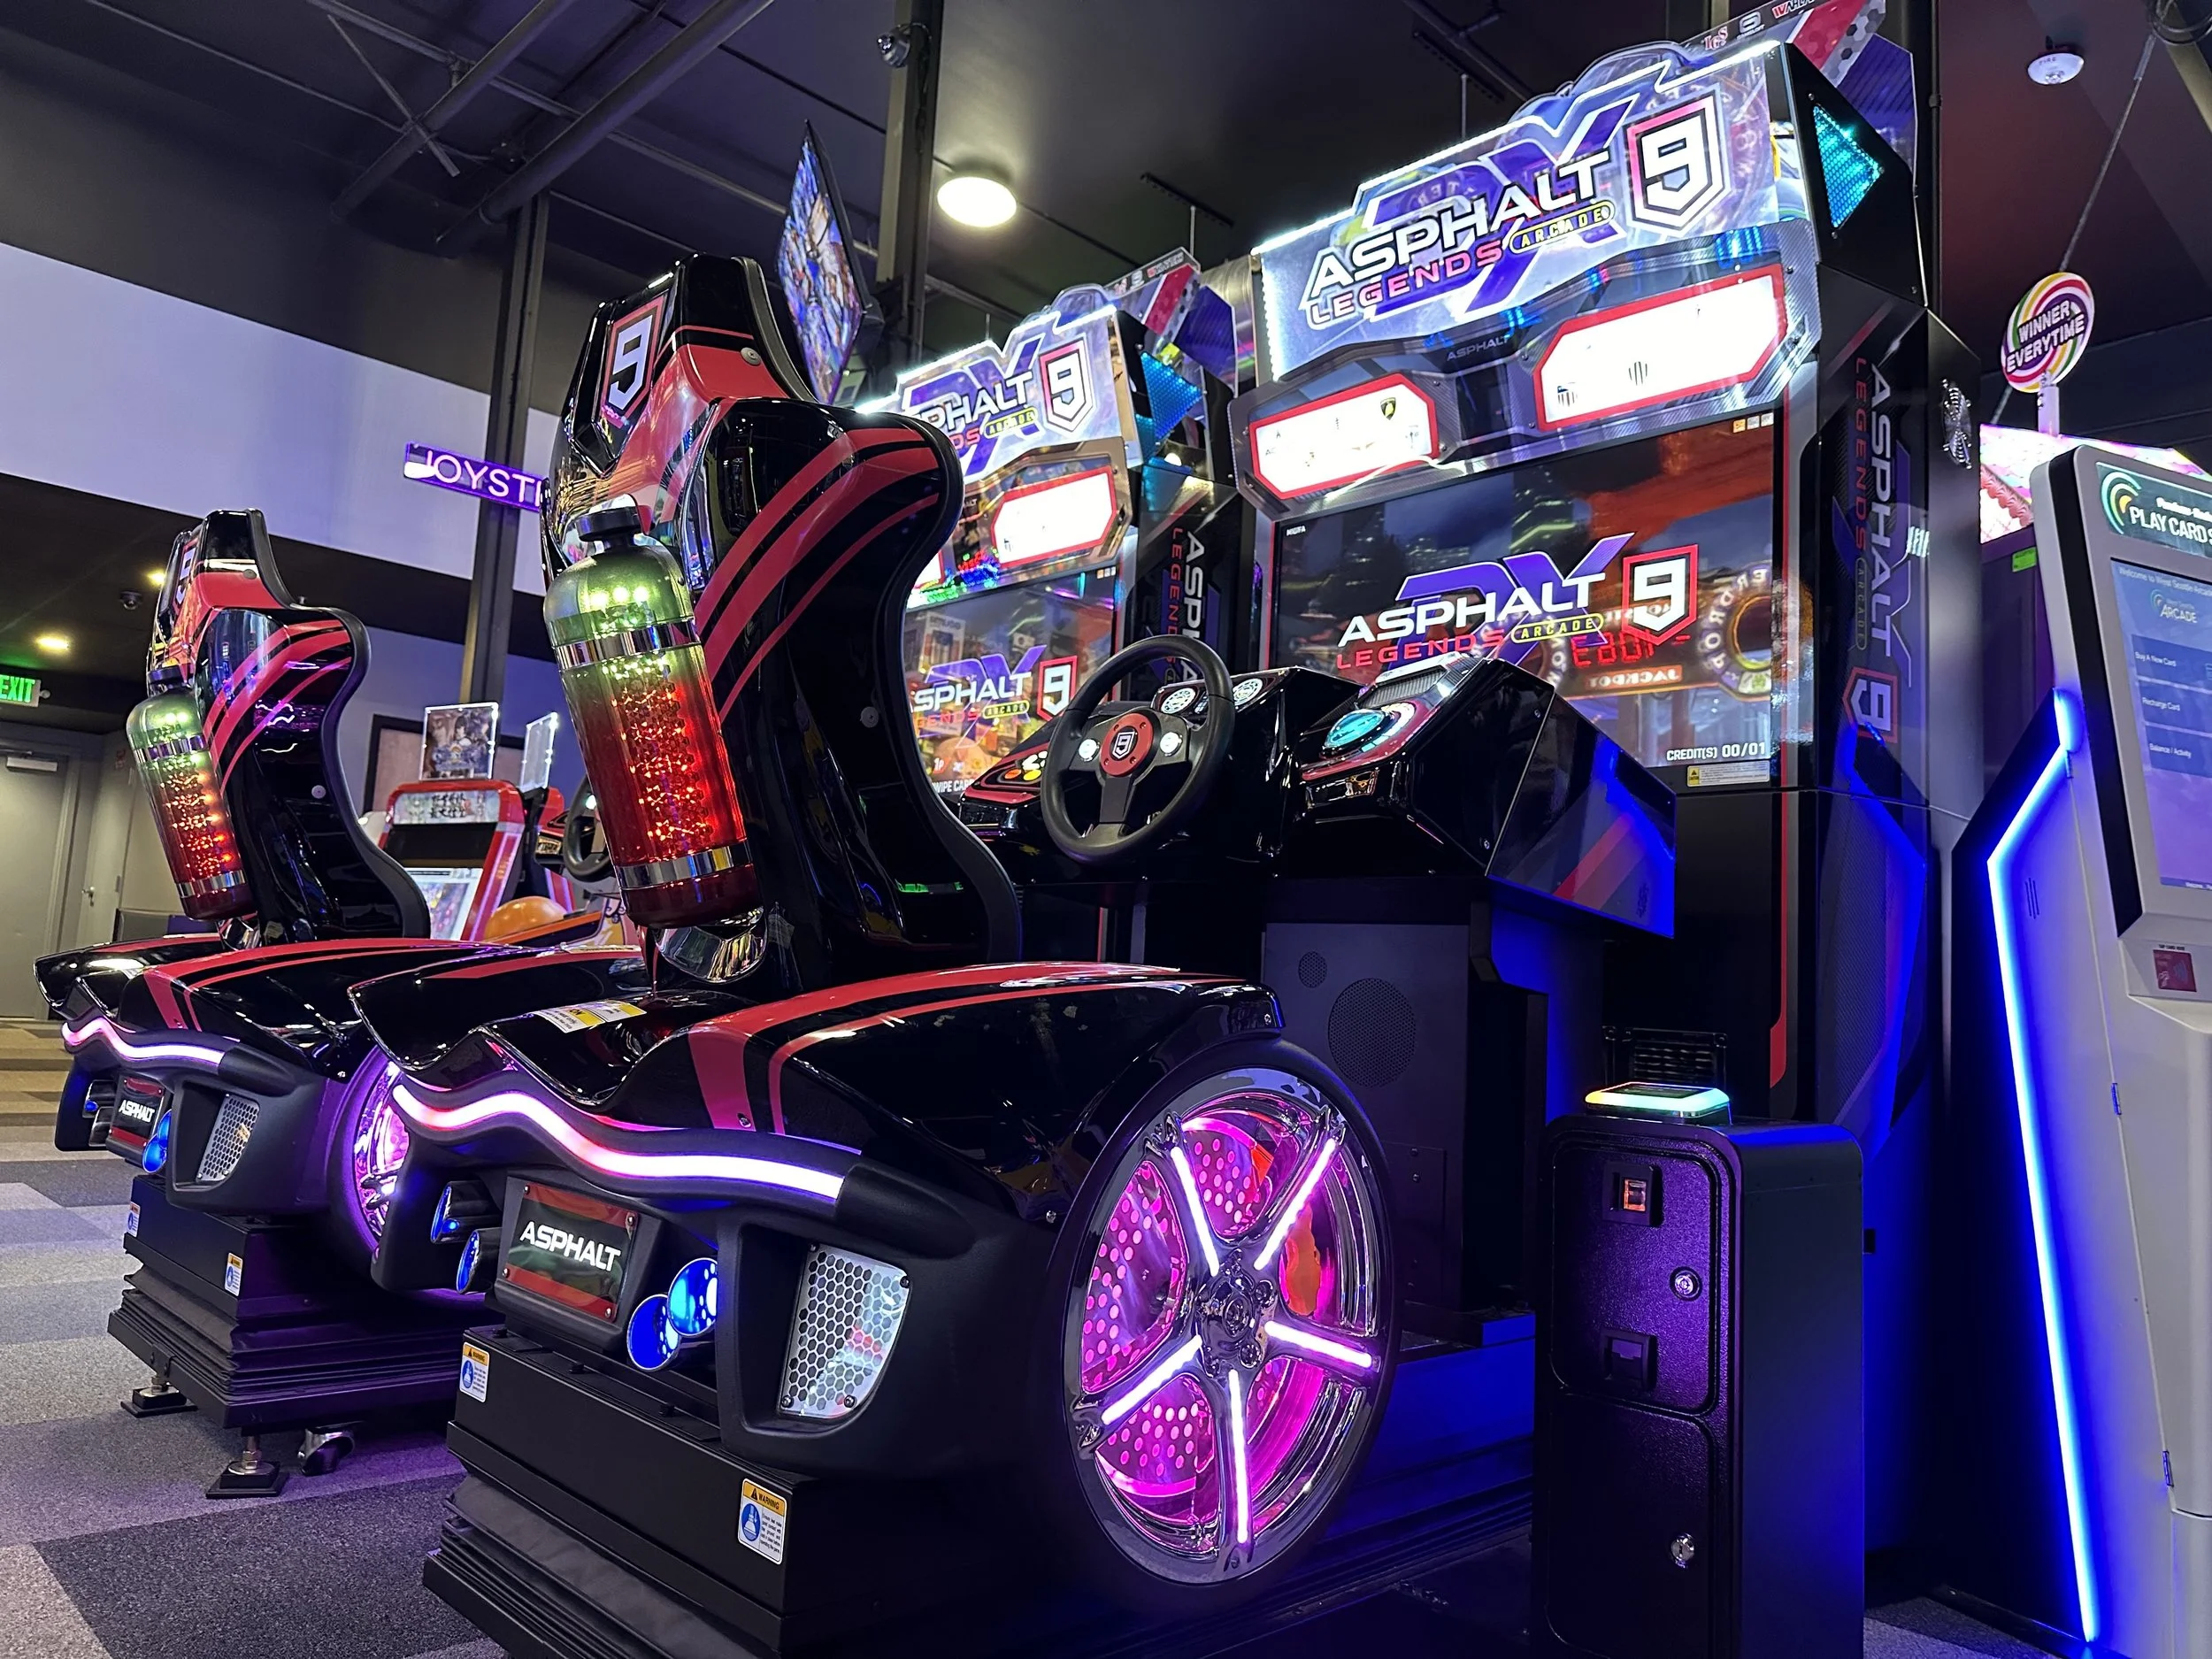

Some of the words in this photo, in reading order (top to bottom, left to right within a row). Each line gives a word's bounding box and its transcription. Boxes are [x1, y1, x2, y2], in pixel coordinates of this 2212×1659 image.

[1310, 150, 1610, 298] ASPHALT
[1641, 115, 1709, 211] 9
[1310, 240, 1504, 324] LEGENDS
[1520, 209, 1604, 249] ARCADE
[2006, 314, 2085, 373] EVERYTIME
[2018, 301, 2070, 343] WINNER
[608, 315, 653, 411] 9
[1447, 336, 1510, 361] ASPHALT
[916, 372, 1033, 431] PHALT
[1048, 353, 1087, 421] 9
[426, 450, 542, 507] JOYSTI
[1855, 357, 1867, 550] LEGENDS
[1871, 364, 1891, 657] ASPHALT
[2129, 506, 2167, 532] PLAY
[1337, 572, 1606, 648] ASPHALT
[1633, 557, 1686, 632] 9
[2160, 604, 2198, 623] ARCADE
[1337, 629, 1505, 670] LEGENDS
[1521, 618, 1594, 641] ARCADE
[2135, 651, 2146, 662] Buy
[0, 674, 35, 703] EXIT
[910, 672, 1032, 713] SPHALT
[1043, 664, 1071, 716] 9
[1850, 679, 1891, 731] 9
[918, 708, 981, 727] GENDS
[987, 703, 1025, 716] ARCADE
[1666, 746, 1718, 761] CREDIT(S)
[1721, 741, 1766, 759] 00/01
[932, 780, 953, 793] WIPE
[118, 1099, 156, 1123] ASPHALT
[519, 1221, 622, 1271] ASPHALT
